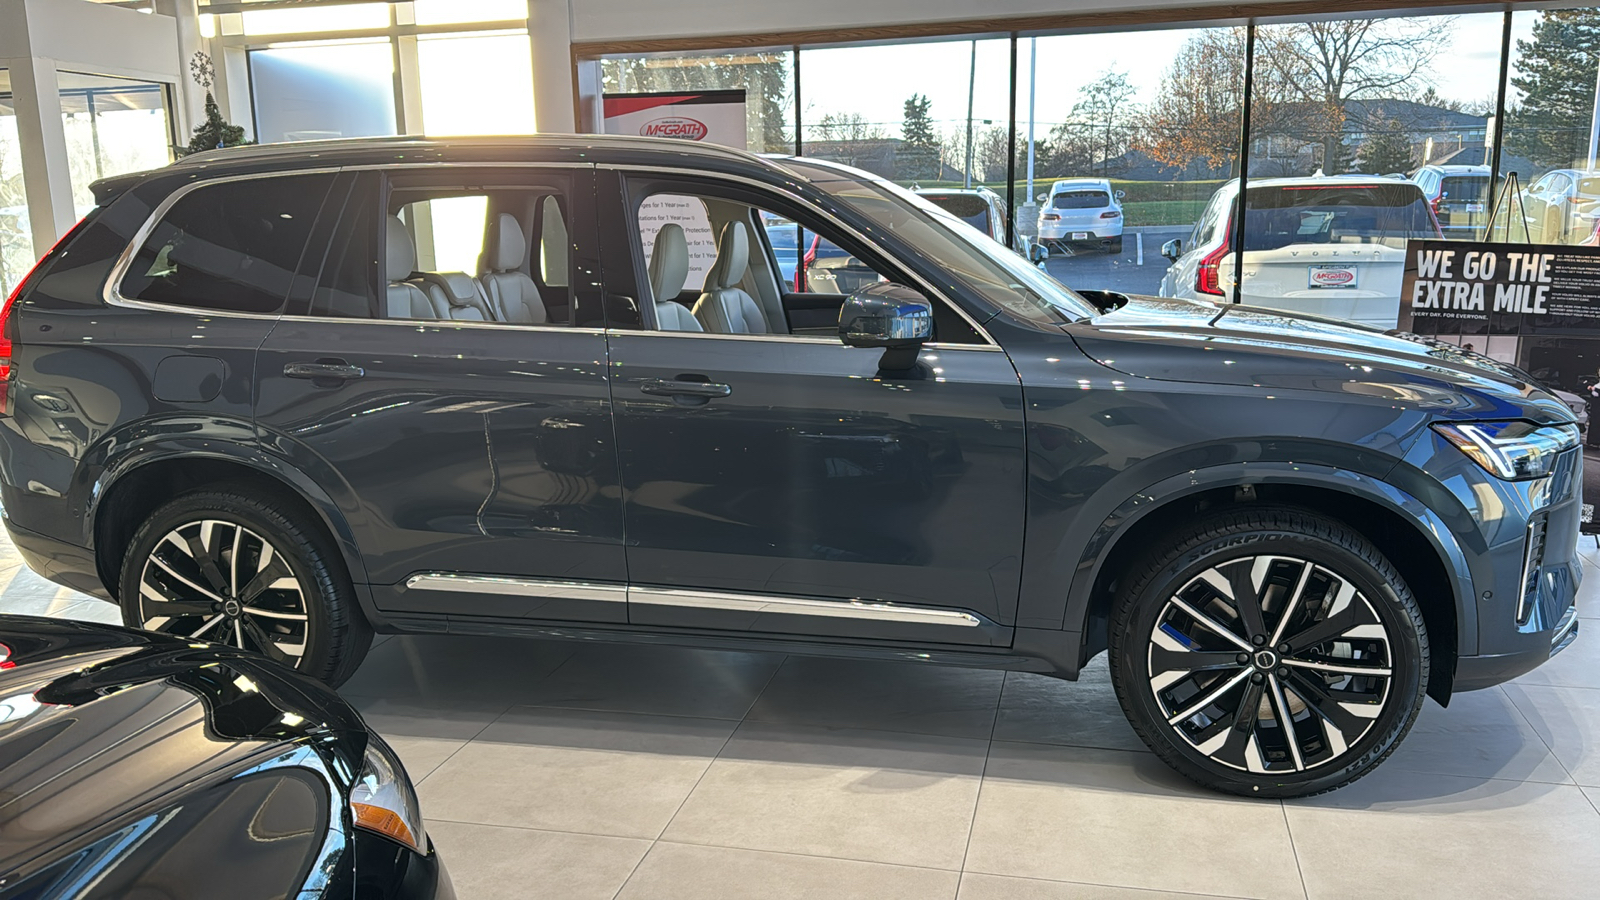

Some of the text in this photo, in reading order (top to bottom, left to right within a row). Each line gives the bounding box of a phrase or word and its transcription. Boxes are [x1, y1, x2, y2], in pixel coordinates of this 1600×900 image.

[1416, 250, 1555, 283] WE GO THE
[1411, 280, 1550, 314] EXTRA MILE
